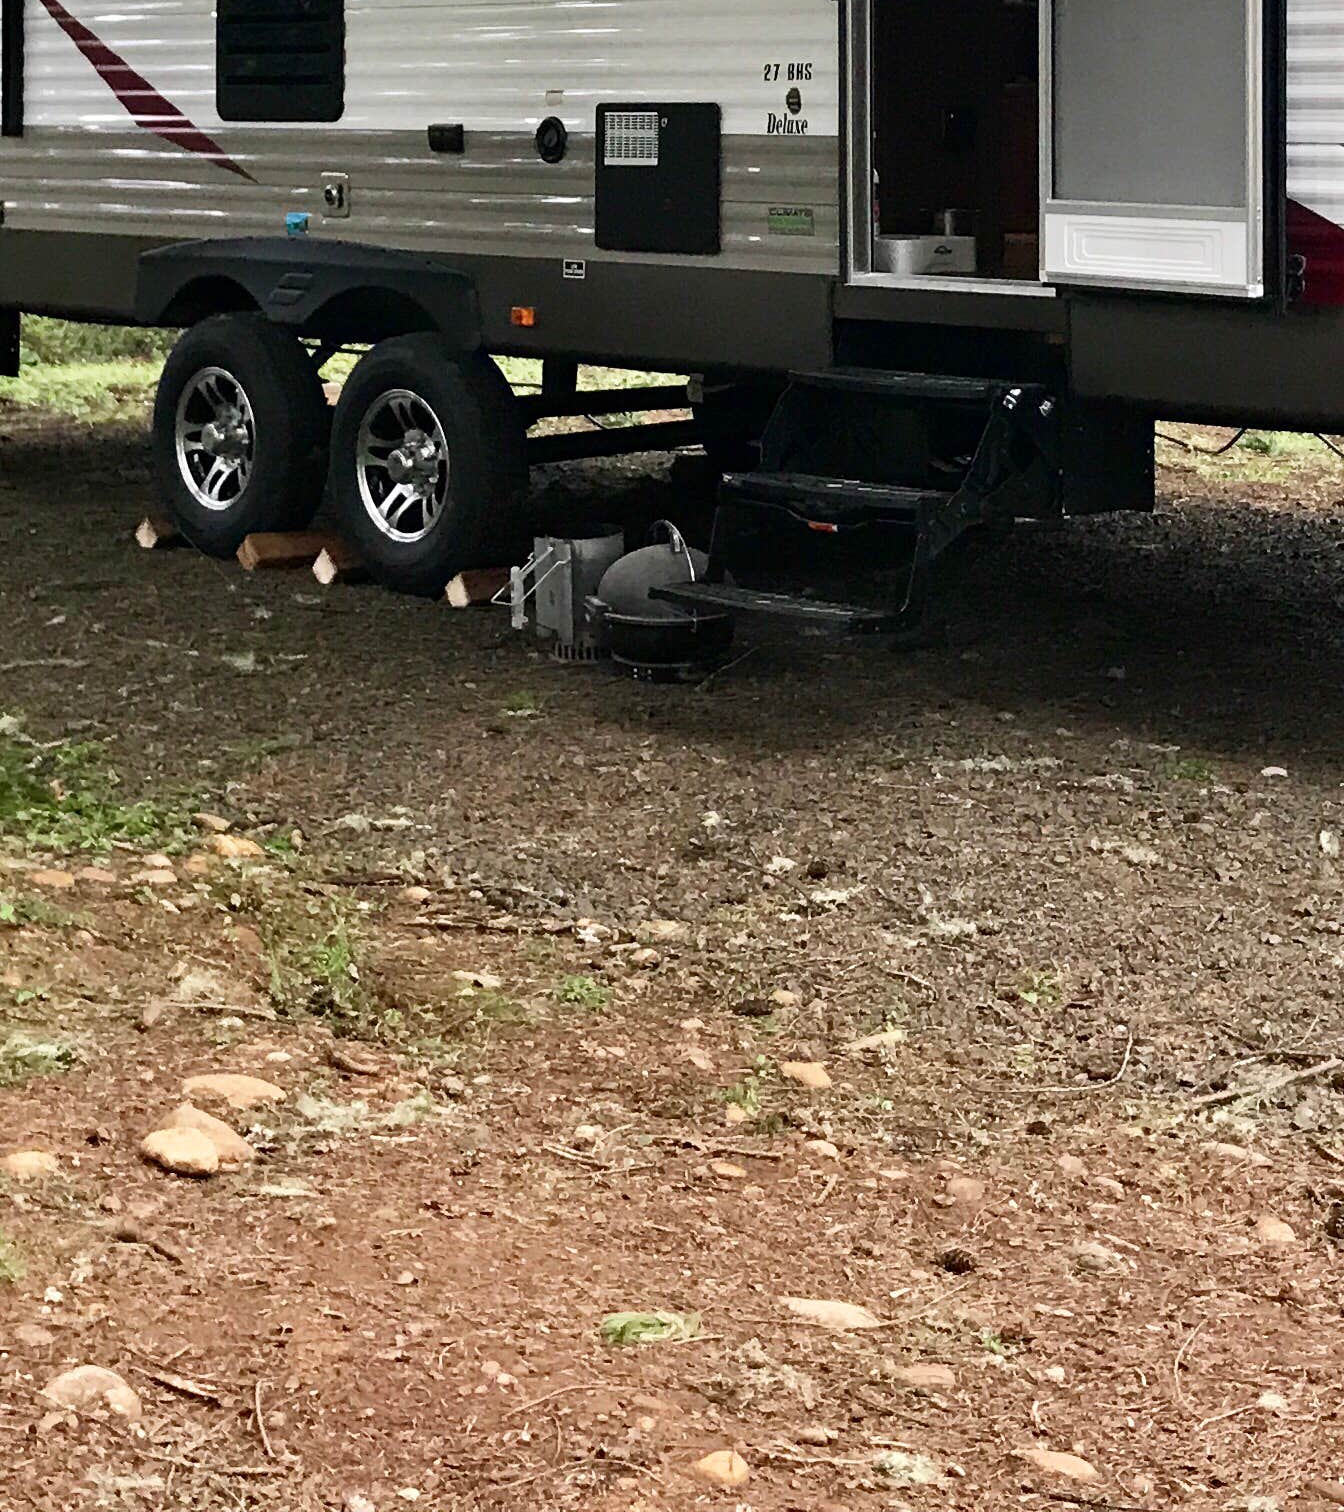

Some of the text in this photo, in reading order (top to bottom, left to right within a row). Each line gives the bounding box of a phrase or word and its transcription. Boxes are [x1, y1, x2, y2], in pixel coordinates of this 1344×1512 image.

[763, 63, 812, 81] 27 BHS
[766, 112, 808, 135] Deluxe
